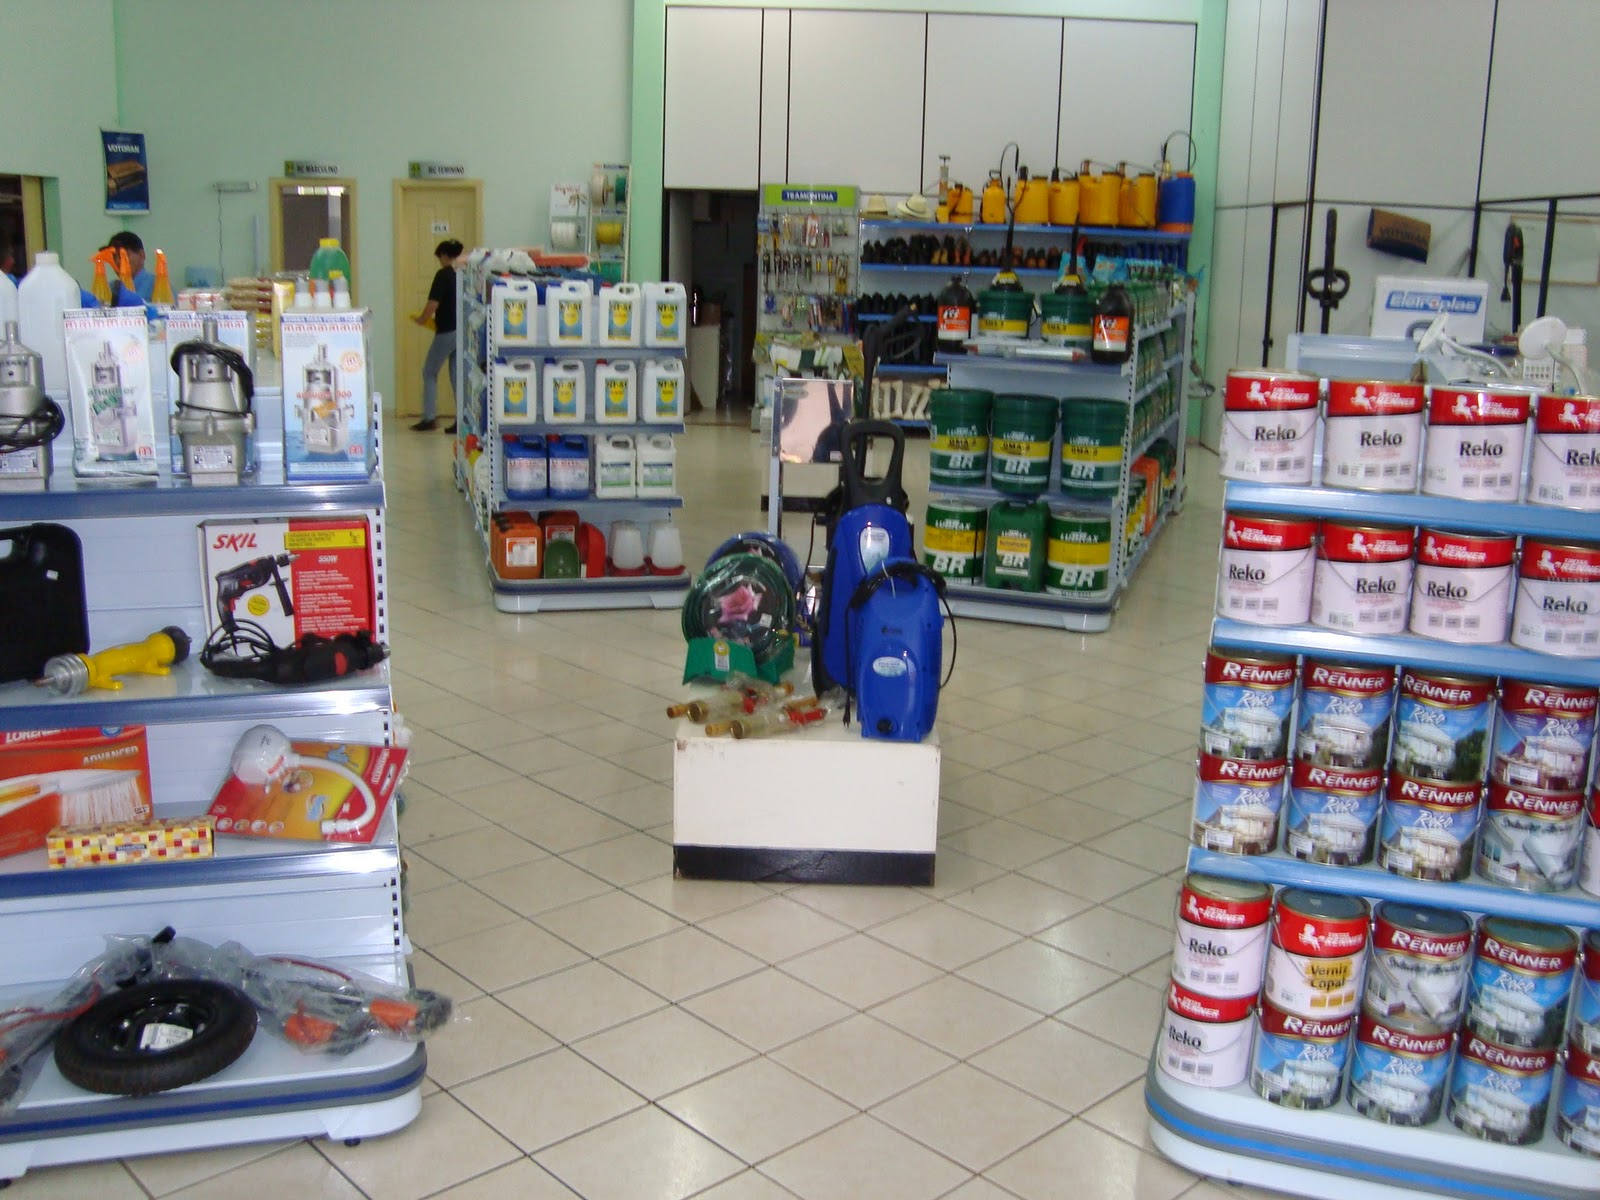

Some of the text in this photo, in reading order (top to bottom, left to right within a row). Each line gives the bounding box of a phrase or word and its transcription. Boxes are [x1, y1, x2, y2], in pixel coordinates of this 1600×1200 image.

[107, 143, 140, 153] VOTORAN
[785, 191, 835, 202] TRAMONTINA
[1270, 391, 1310, 402] RENNER
[1254, 424, 1297, 441] Reko
[1360, 430, 1403, 447] Reko
[1460, 439, 1504, 457] Reko
[1566, 448, 1600, 466] Rek
[949, 453, 975, 470] BR
[1004, 459, 1032, 474] BR
[1070, 464, 1097, 480] BR
[935, 518, 972, 531] LUBRAX
[213, 533, 257, 552] SKIL
[1060, 531, 1099, 544] LUBRAX
[1240, 531, 1283, 544] RENNER
[1002, 553, 1026, 568] BR
[1441, 548, 1487, 562] RENNER
[932, 554, 967, 575] BR
[1229, 563, 1266, 581] Reko
[1059, 566, 1096, 588] BR
[1356, 576, 1396, 594] Reko
[1427, 580, 1468, 598] Reko
[1543, 595, 1588, 613] Reko
[1223, 662, 1293, 682] RENNER
[1312, 667, 1385, 689] RENNER
[1403, 674, 1472, 701] RENNER
[1525, 688, 1597, 710] RENNER
[83, 745, 139, 765] ADVANCED
[1220, 760, 1286, 780] RENNER
[1309, 767, 1378, 789] RENNER
[1401, 780, 1475, 804] RENNER
[1505, 790, 1579, 813] RENNER
[1203, 909, 1245, 924] RENNER
[1189, 937, 1228, 957] Reko
[1391, 929, 1466, 955] RENNER
[1484, 938, 1561, 969] RENNER
[1311, 963, 1348, 977] Verniz
[1310, 977, 1346, 993] Copal
[1179, 1001, 1220, 1018] RENNER
[1168, 1025, 1202, 1048] Reko
[1371, 1025, 1446, 1052] RENNER
[1468, 1038, 1546, 1069] RENNER
